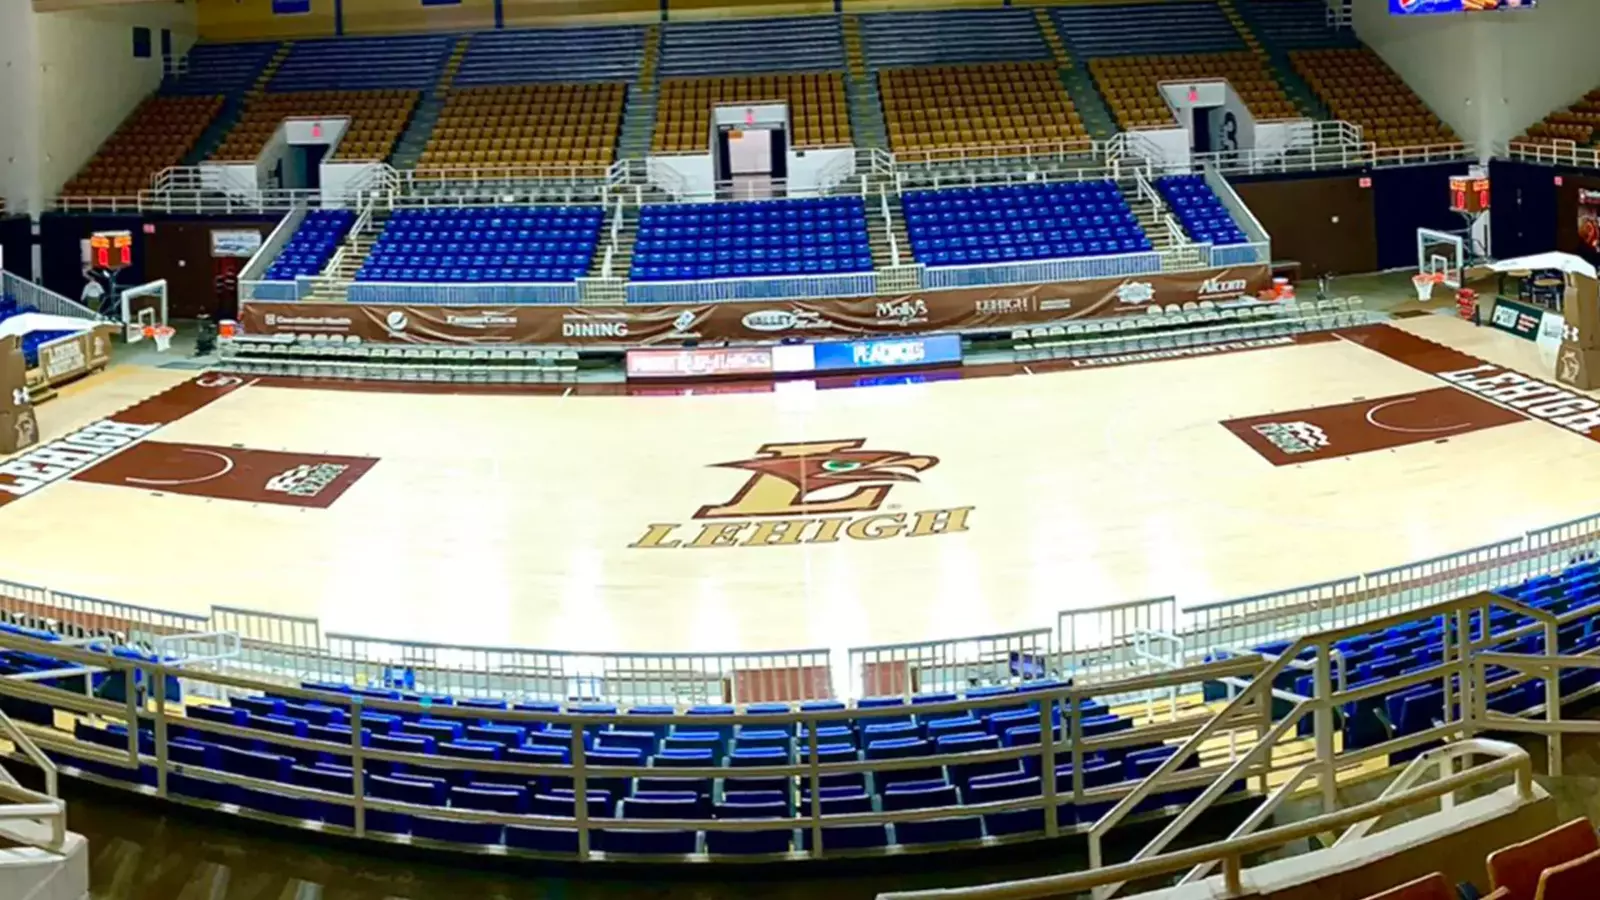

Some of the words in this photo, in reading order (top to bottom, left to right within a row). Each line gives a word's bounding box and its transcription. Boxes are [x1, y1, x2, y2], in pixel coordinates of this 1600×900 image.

[876, 300, 928, 318] Molly's
[976, 297, 1028, 311] LEHIGH
[562, 322, 628, 336] DINING
[748, 315, 791, 326] VALLEY
[1433, 364, 1600, 434] LEHIGH
[0, 419, 164, 496] LEHIGH
[627, 505, 976, 549] LEHIGH
